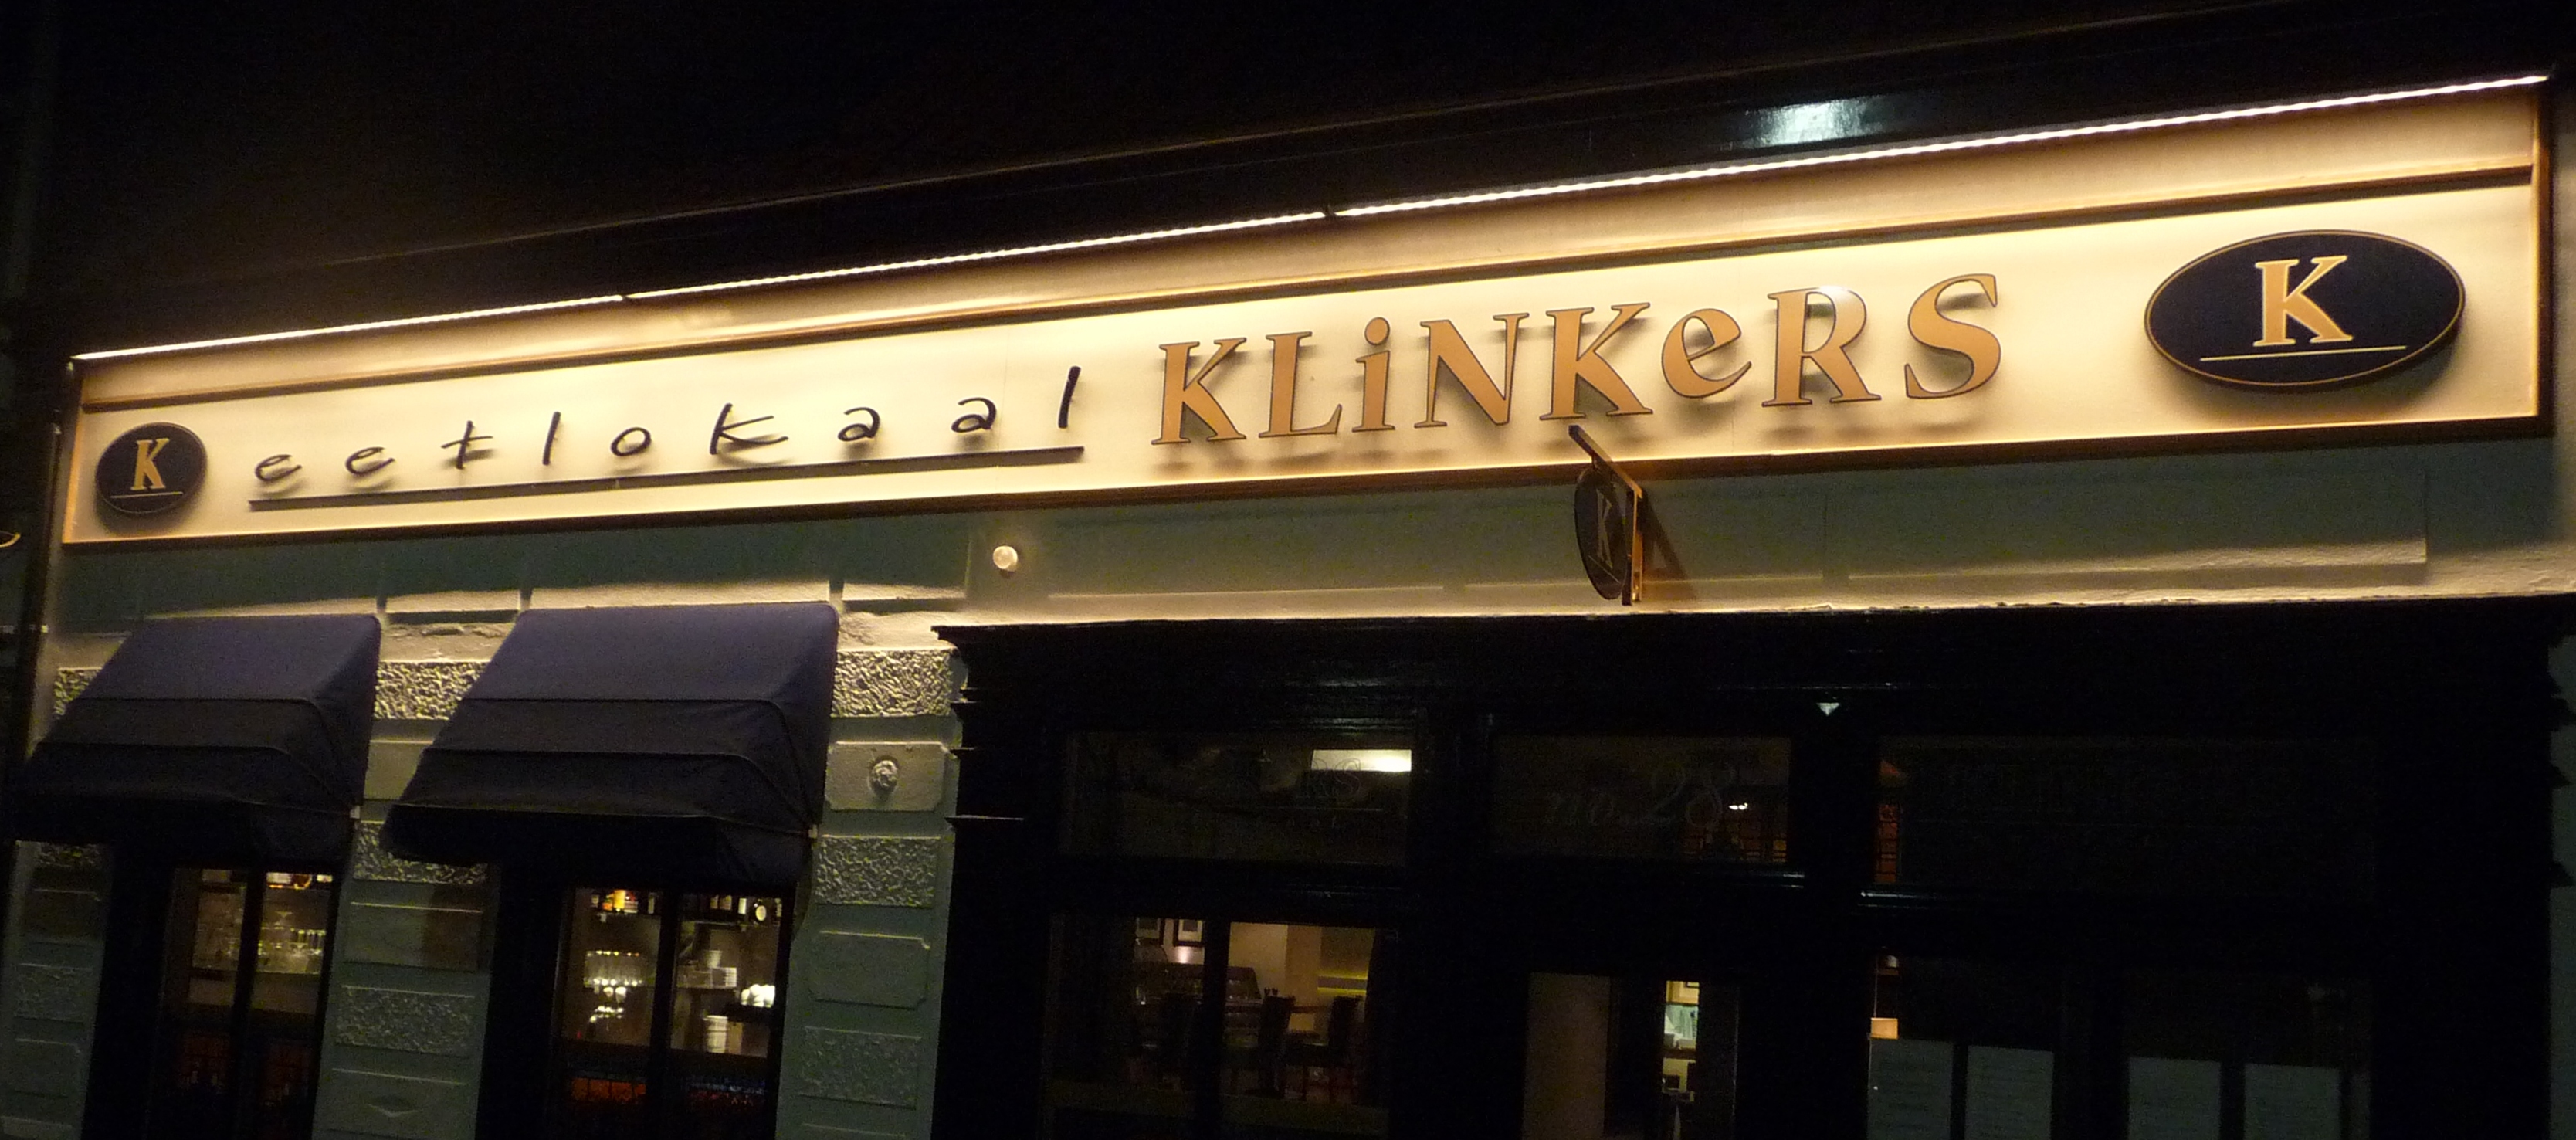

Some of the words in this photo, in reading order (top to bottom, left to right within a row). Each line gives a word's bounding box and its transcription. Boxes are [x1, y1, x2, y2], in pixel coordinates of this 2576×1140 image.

[2252, 255, 2354, 347] K
[130, 437, 170, 491] K
[255, 365, 1080, 482] eetlokaal
[1595, 487, 1614, 571] K
